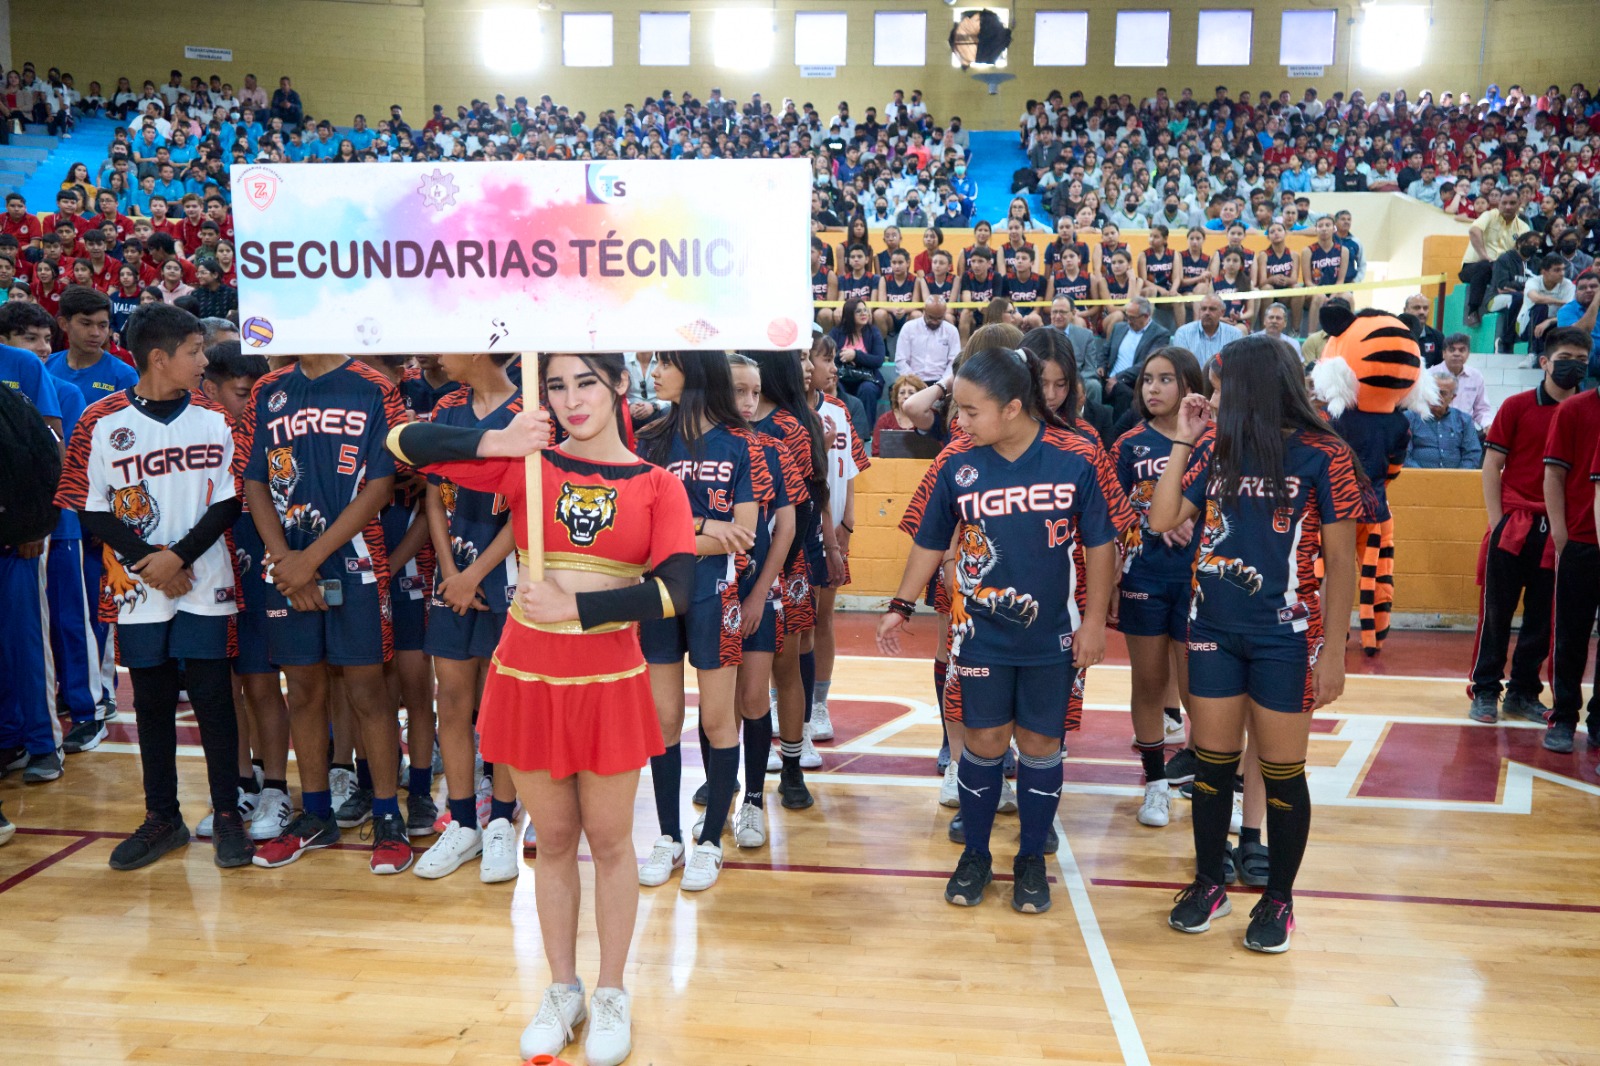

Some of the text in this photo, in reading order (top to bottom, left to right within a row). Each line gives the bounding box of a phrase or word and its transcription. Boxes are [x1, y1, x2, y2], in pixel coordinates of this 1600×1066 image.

[240, 230, 746, 279] SECUNDARIAS TÉCNIC
[1312, 257, 1340, 269] TIGRES
[267, 407, 368, 445] TIGRES
[112, 444, 224, 484] TIGRES
[337, 443, 360, 475] 5
[206, 478, 214, 506] 1
[957, 483, 1076, 521] TIGRES
[1045, 518, 1071, 548] 10
[1272, 507, 1295, 533] 6
[1122, 590, 1149, 600] TIGRES
[1188, 641, 1218, 651] TIGRES
[956, 665, 990, 677] TIGRES
